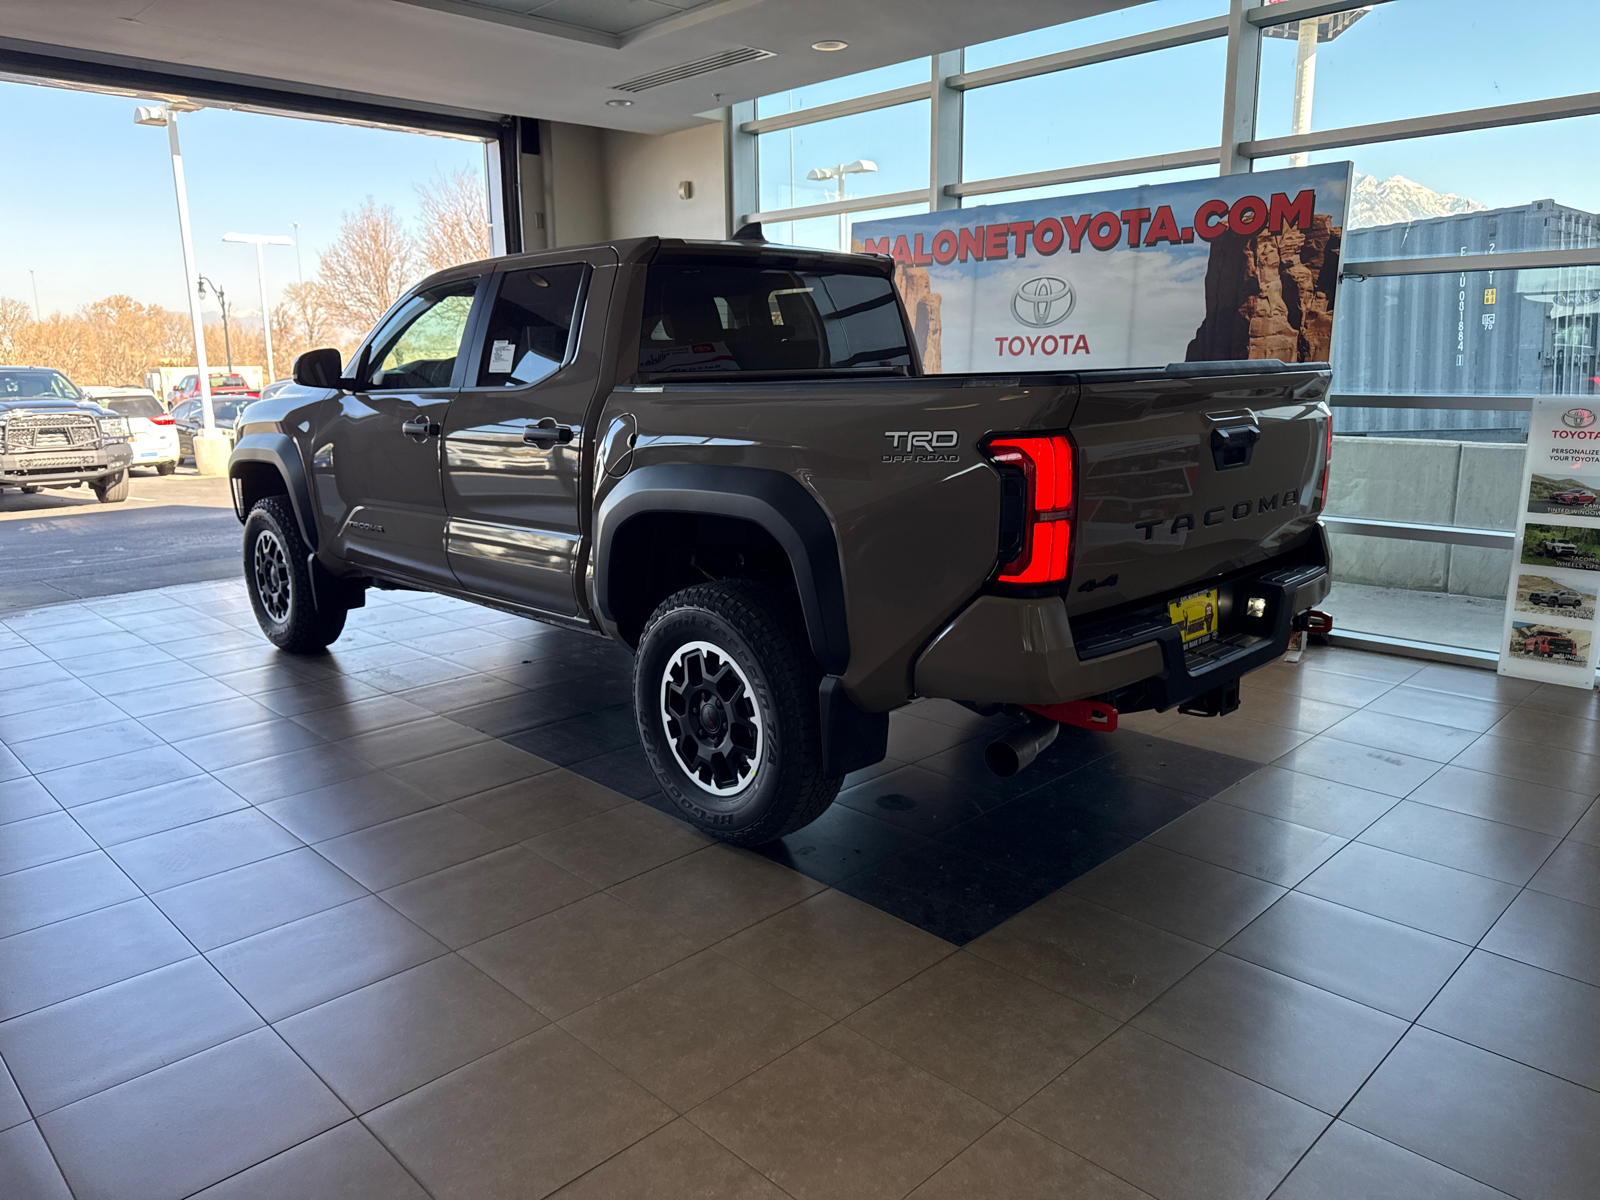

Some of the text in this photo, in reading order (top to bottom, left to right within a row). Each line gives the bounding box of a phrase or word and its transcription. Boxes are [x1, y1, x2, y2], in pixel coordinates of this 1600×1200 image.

[865, 189, 1315, 267] MALONETOYOTA.COM
[994, 334, 1091, 357] TOYOTA
[884, 430, 959, 454] TRD
[1552, 430, 1600, 440] TOYOTA
[881, 455, 960, 463] OFF ROAD
[1551, 448, 1600, 456] PERSONALIZE
[1134, 488, 1299, 543] TACOMA
[1571, 555, 1600, 563] TACOMA
